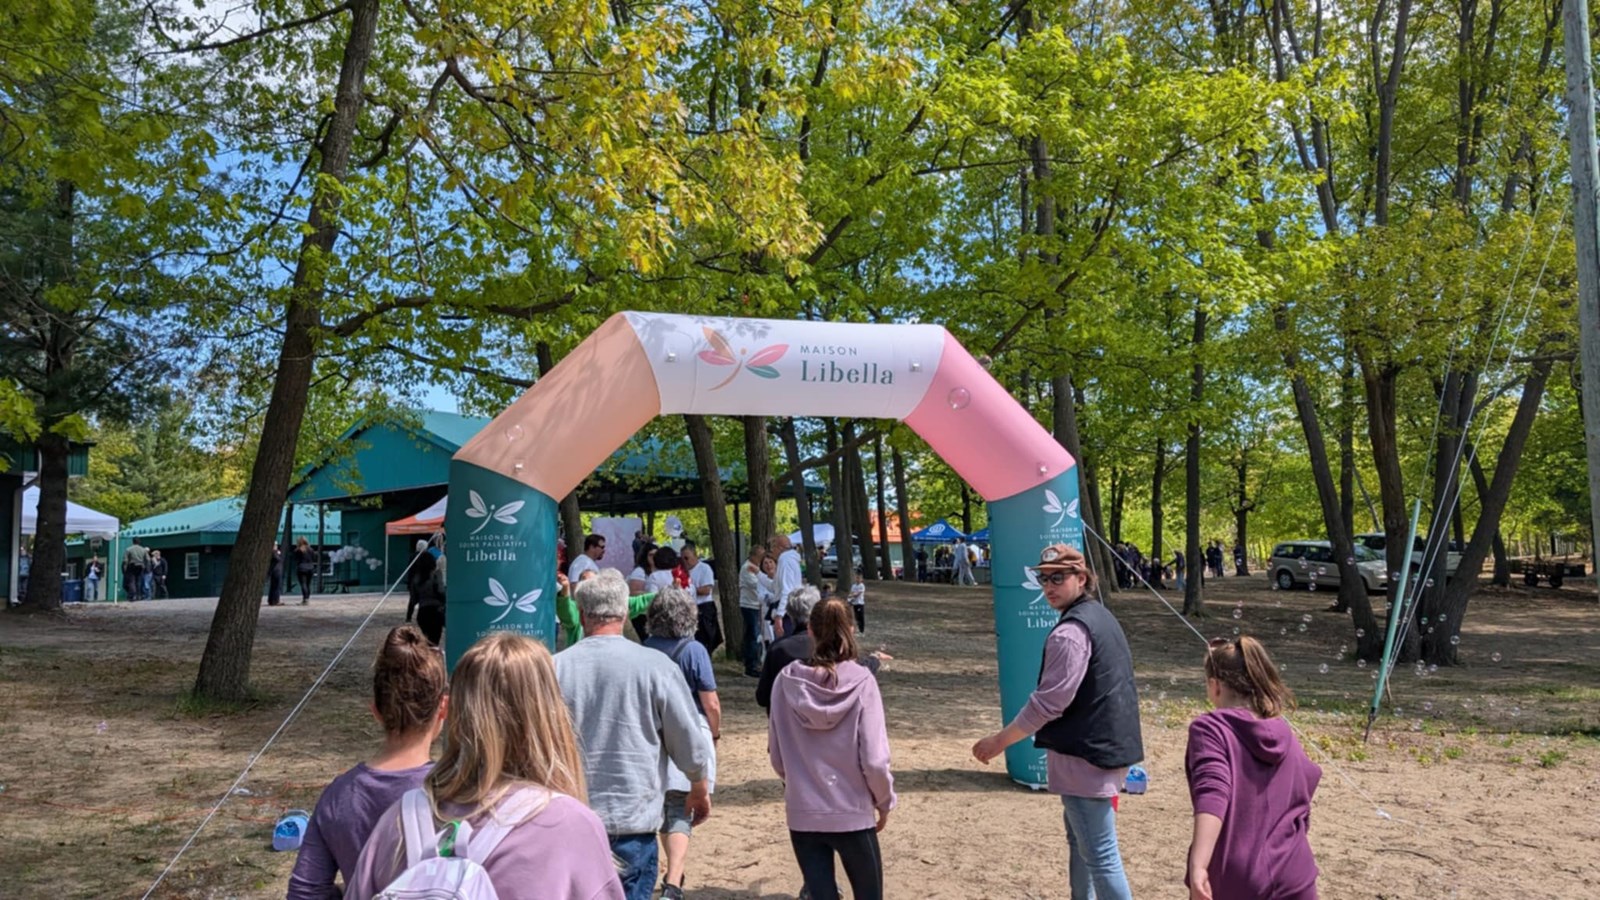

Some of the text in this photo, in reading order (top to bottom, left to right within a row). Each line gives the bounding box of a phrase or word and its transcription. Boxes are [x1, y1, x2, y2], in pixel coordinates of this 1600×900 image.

[800, 345, 858, 356] MAISON
[801, 360, 894, 385] Libella
[466, 549, 517, 562] Libella
[1027, 617, 1060, 628] Libel
